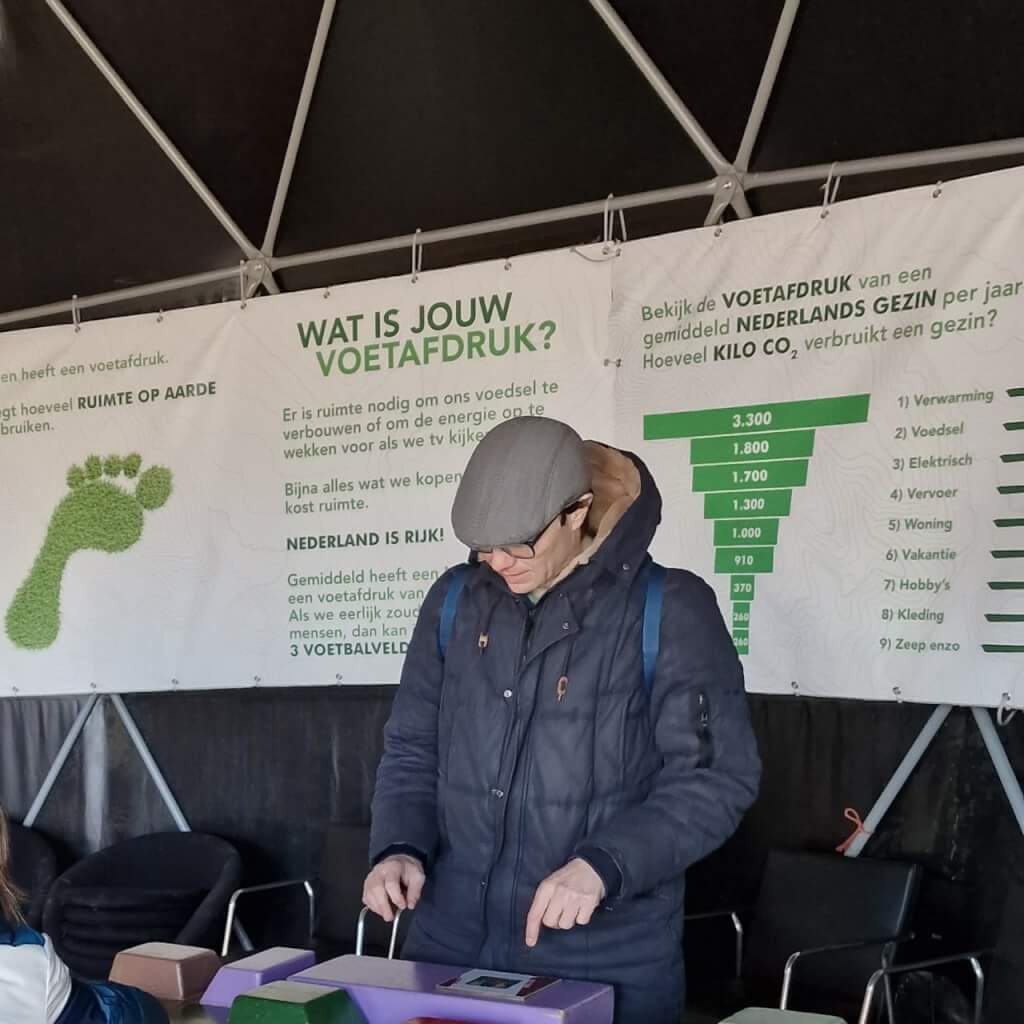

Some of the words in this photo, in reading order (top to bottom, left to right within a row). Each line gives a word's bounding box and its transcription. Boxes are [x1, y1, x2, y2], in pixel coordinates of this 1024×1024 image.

[642, 299, 692, 321] Bekijk
[696, 296, 716, 313] de
[722, 274, 852, 309] VOETAFDRUK
[859, 273, 891, 290] van
[897, 266, 932, 285] een
[297, 314, 363, 348] WAT
[375, 309, 399, 339] IS
[411, 292, 512, 333] JOUW
[643, 319, 730, 349] gemiddeld
[736, 300, 866, 334] NEDERLANDS
[872, 290, 937, 315] GEZIN
[942, 285, 978, 309] per
[982, 280, 1022, 299] jaar
[643, 347, 708, 369] Hoeveel
[714, 340, 757, 361] KILO
[804, 325, 888, 351] verbruikt
[892, 323, 924, 340] een
[930, 309, 998, 340] gezin?
[316, 320, 557, 377] VOETAFDRUK?
[21, 365, 56, 381] heeft
[60, 364, 84, 376] een
[89, 351, 168, 372] voetafdruk.
[21, 399, 73, 415] hoeveel
[77, 392, 133, 409] RUIMTE
[138, 389, 160, 403] OP
[164, 382, 217, 400] AARDE
[283, 408, 299, 422] Er
[301, 406, 313, 420] is
[317, 402, 363, 419] ruimte
[367, 396, 409, 413] nodig
[415, 395, 439, 408] om
[443, 392, 470, 405] ons
[475, 381, 537, 400] voedsel
[542, 381, 559, 394] te
[897, 395, 910, 408] 1)
[914, 389, 994, 406] Verwarming
[283, 421, 361, 442] verbouwen
[367, 419, 382, 433] of
[386, 417, 409, 430] om
[415, 413, 433, 427] de
[438, 408, 497, 425] energie
[528, 403, 545, 416] te
[732, 412, 773, 428] 3.300
[895, 427, 908, 440] 2)
[912, 423, 965, 438] Voedsel
[283, 443, 337, 459] wekken
[342, 440, 374, 453] voor
[379, 435, 398, 450] als
[403, 435, 426, 448] we
[430, 432, 444, 445] tv
[733, 441, 769, 455] 1.800
[892, 457, 905, 471] 3)
[909, 454, 973, 469] Elektrisch
[285, 481, 319, 497] Bijna
[322, 478, 354, 494] alles
[358, 476, 385, 489] wat
[390, 474, 411, 487] we
[416, 471, 463, 488] kopen
[732, 469, 768, 483] 1.700
[890, 488, 903, 501] 4)
[908, 487, 958, 500] Vervoer
[285, 499, 315, 514] kost
[319, 497, 369, 512] ruimte.
[733, 498, 765, 511] 1.300
[732, 527, 761, 538] 1.000
[888, 519, 901, 532] 5)
[904, 518, 953, 533] Woning
[286, 533, 380, 551] NEDERLAND
[385, 531, 399, 545] IS
[404, 528, 444, 544] RIJK!
[734, 555, 754, 565] 910
[886, 549, 898, 562] 6)
[902, 548, 957, 561] Vakantie
[288, 570, 365, 587] Gemiddeld
[369, 569, 408, 583] heeft
[413, 569, 439, 581] een
[883, 579, 897, 592] 7)
[288, 590, 314, 604] een
[318, 587, 395, 602] voetafdruk
[399, 588, 424, 600] van
[734, 582, 752, 593] 370
[288, 608, 310, 622] Als
[314, 608, 335, 621] we
[339, 606, 382, 623] eerlijk
[881, 609, 894, 621] 8)
[897, 608, 945, 624] Kleding
[289, 626, 346, 641] mensen,
[352, 624, 377, 638] dan
[382, 624, 408, 637] kan
[290, 645, 299, 657] 3
[879, 638, 892, 650] 9)
[895, 639, 926, 653] Zeep
[930, 641, 960, 651] enzo
